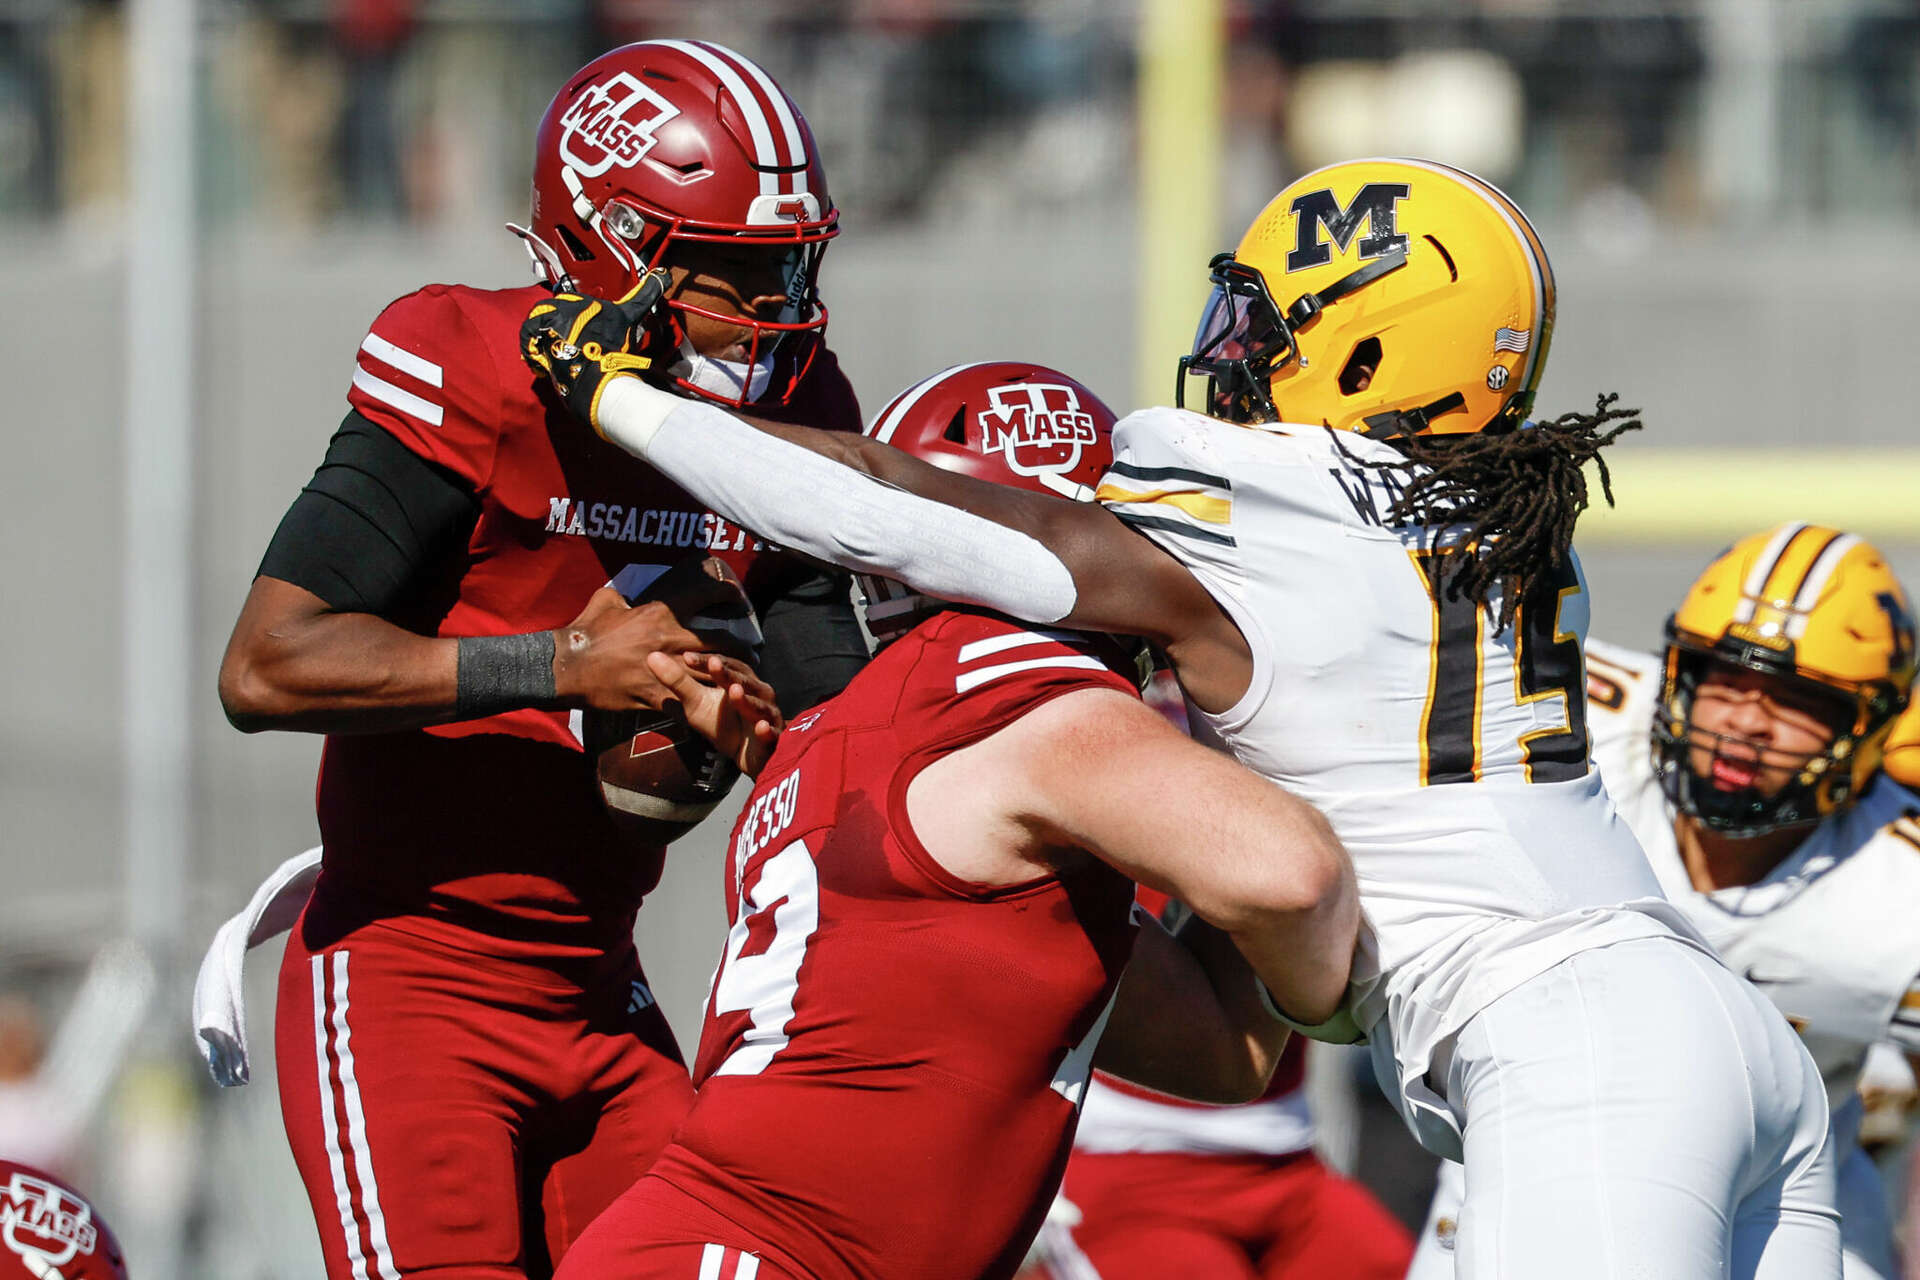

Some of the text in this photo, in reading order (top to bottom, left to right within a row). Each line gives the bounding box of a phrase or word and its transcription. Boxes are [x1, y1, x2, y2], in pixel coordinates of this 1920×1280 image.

[564, 88, 652, 163] MASS
[1286, 183, 1411, 273] M
[982, 406, 1094, 450] MASS
[545, 497, 782, 551] MASSACHUSE
[1405, 545, 1592, 786] 15
